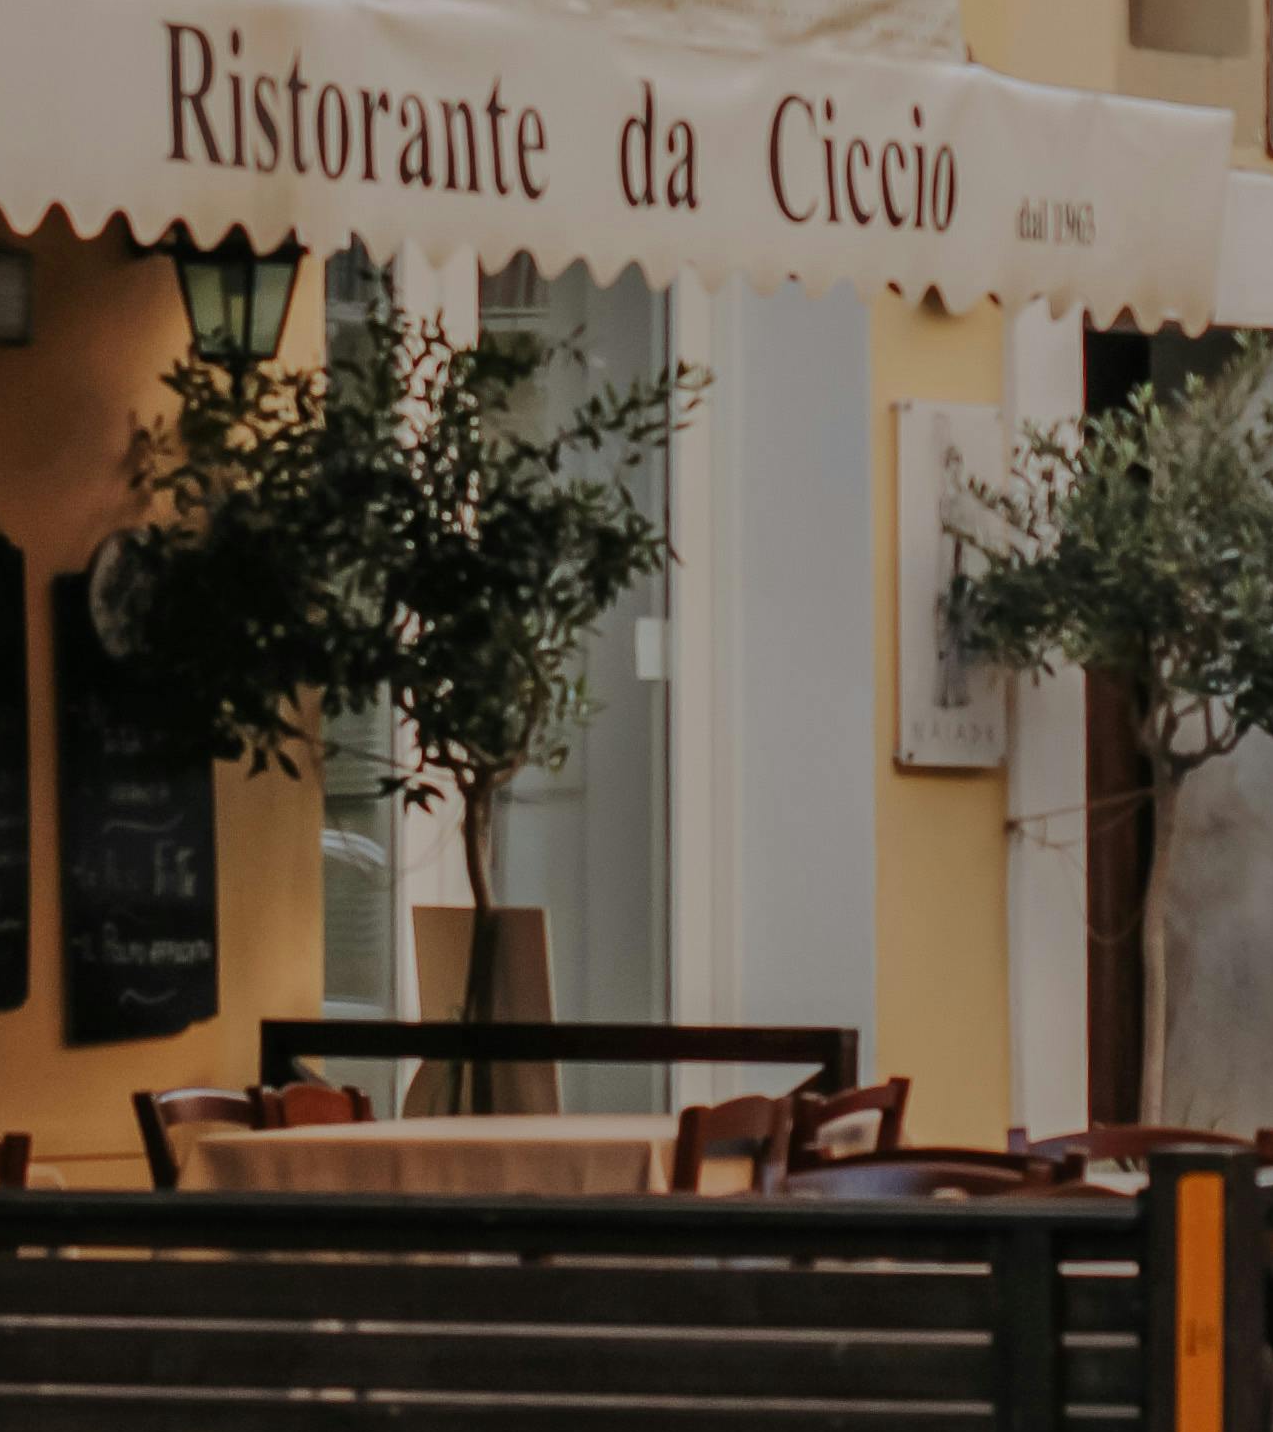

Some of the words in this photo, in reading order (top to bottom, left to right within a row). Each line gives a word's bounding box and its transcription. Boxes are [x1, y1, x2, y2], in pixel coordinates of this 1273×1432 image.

[165, 23, 549, 200] Ristorante
[618, 80, 699, 211] da
[769, 93, 960, 232] Ciccio
[1015, 196, 1047, 241] dal
